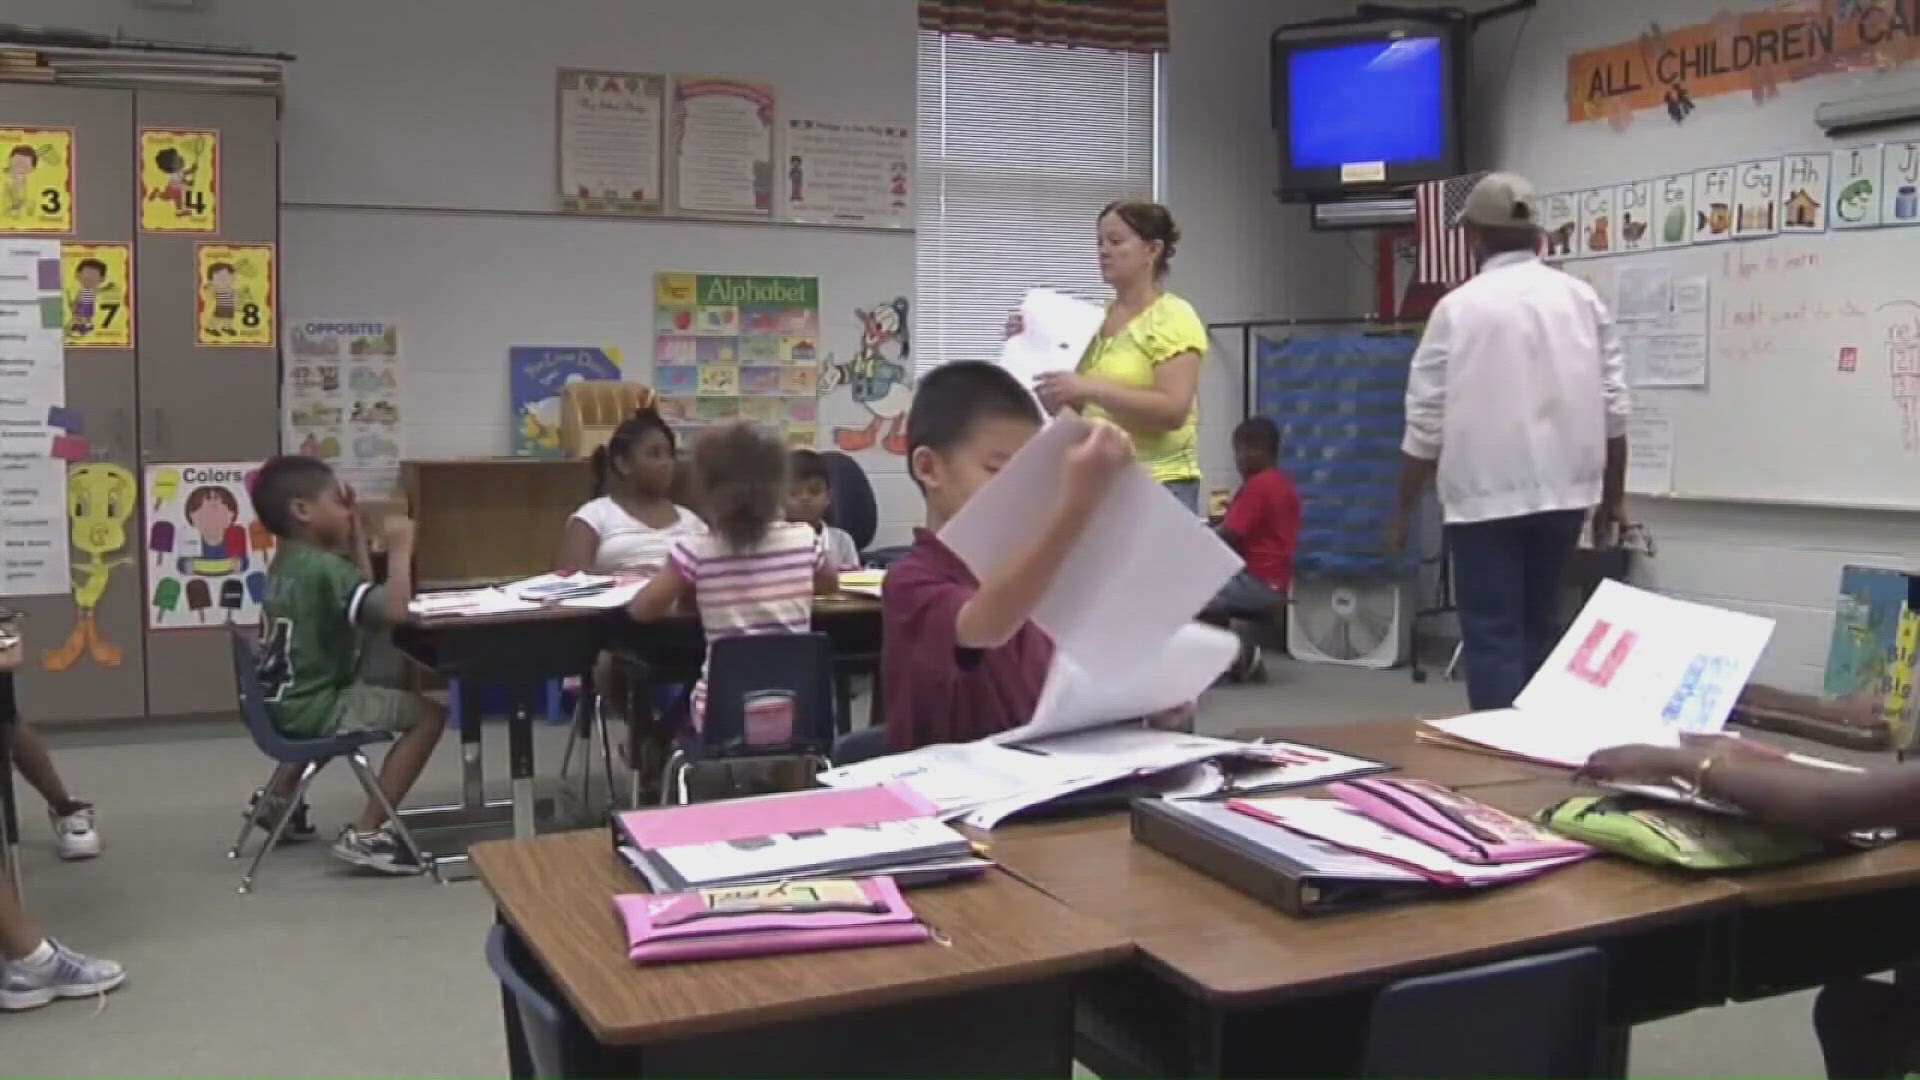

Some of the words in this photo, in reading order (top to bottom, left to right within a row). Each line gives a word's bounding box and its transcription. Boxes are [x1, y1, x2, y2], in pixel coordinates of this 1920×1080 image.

[1588, 60, 1642, 100] ALL
[1655, 17, 1834, 86] CHILDREN
[1858, 0, 1920, 45] CA
[1743, 162, 1773, 198] Gg
[1791, 157, 1819, 183] Hh
[41, 189, 62, 215] 3
[185, 190, 207, 215] 4
[706, 276, 806, 304] Alphabet
[100, 303, 121, 329] 7
[242, 303, 261, 328] 8
[305, 322, 385, 337] OPPOSITES
[182, 467, 243, 484] Colors
